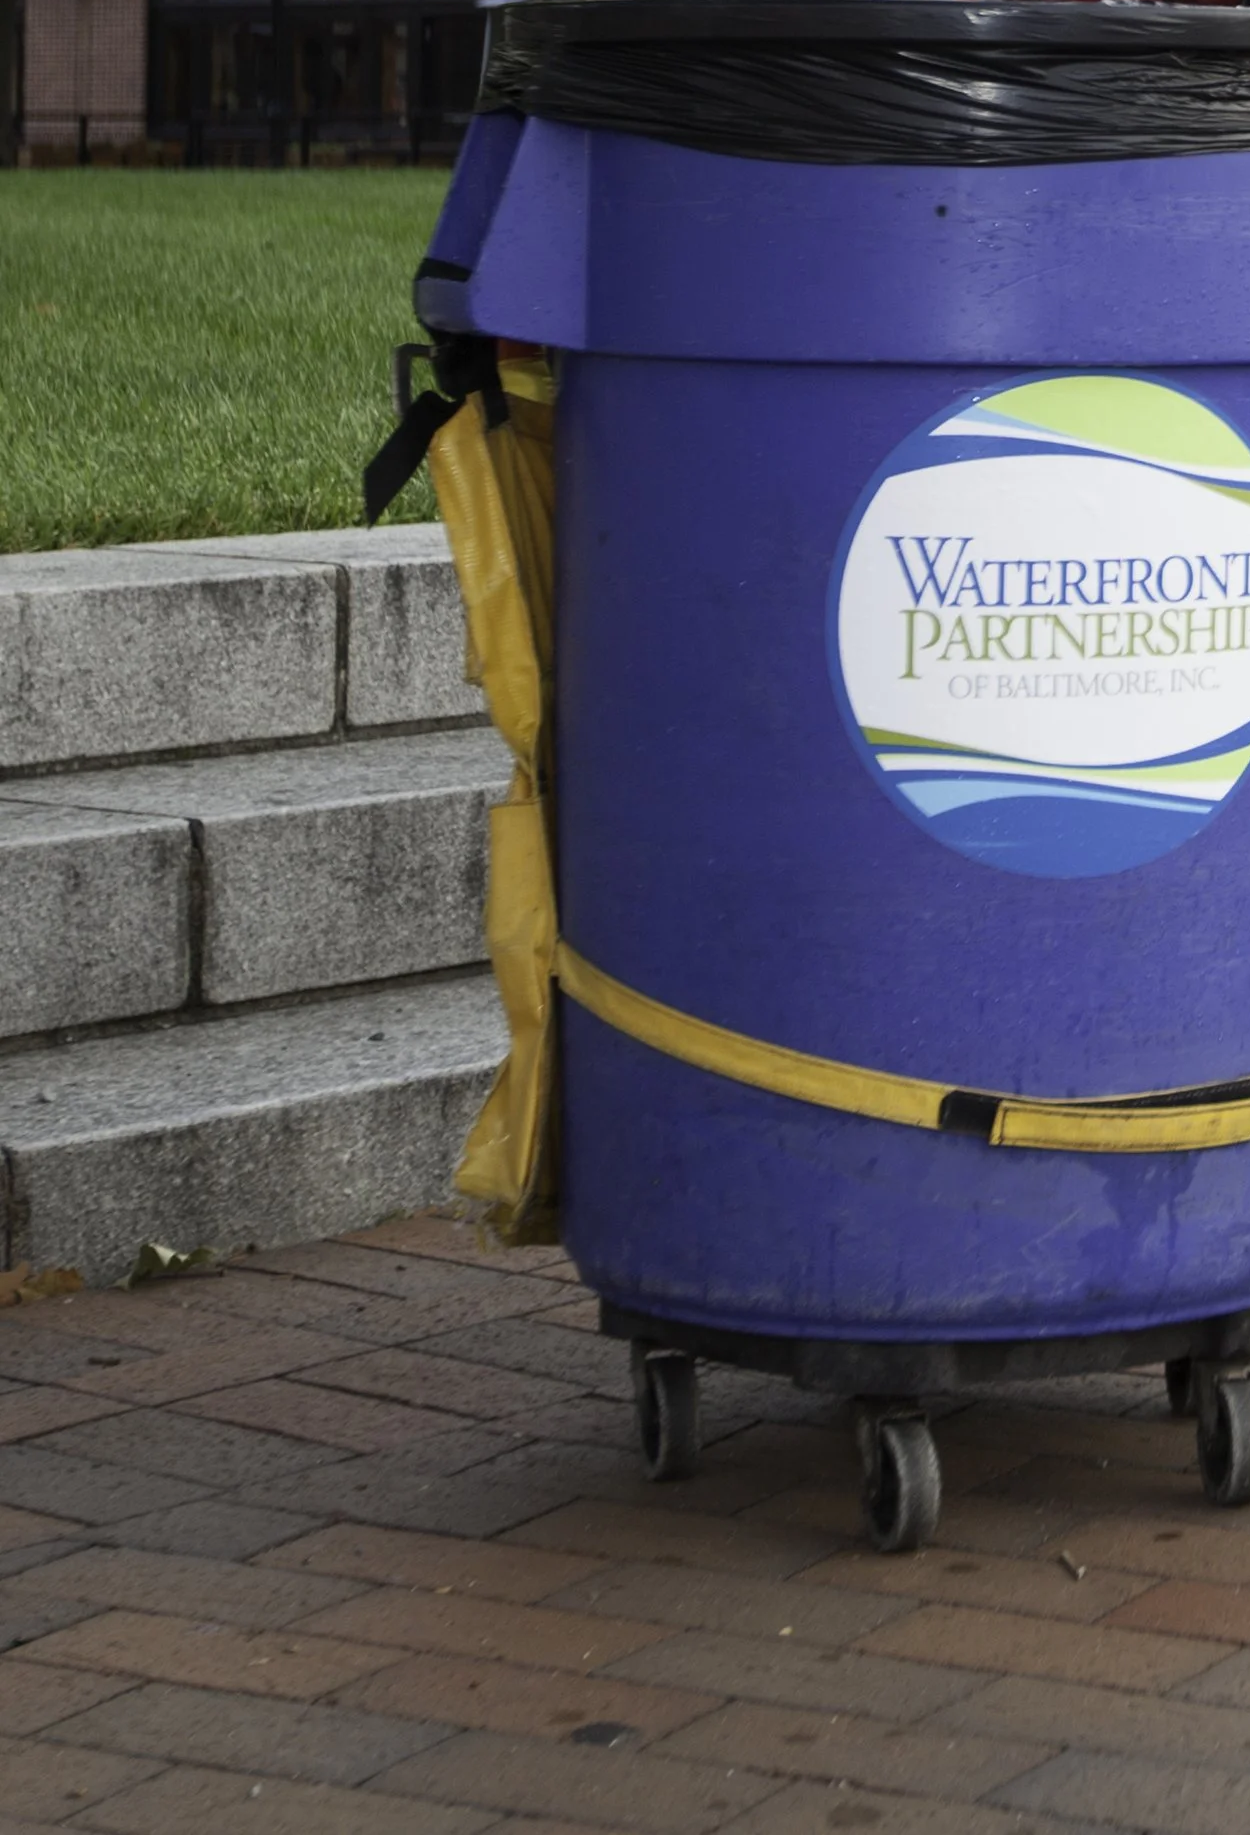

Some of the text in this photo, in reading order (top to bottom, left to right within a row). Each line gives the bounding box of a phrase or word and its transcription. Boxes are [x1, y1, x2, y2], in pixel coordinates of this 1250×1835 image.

[947, 666, 1221, 700] OF BALTIMORE, INC.
